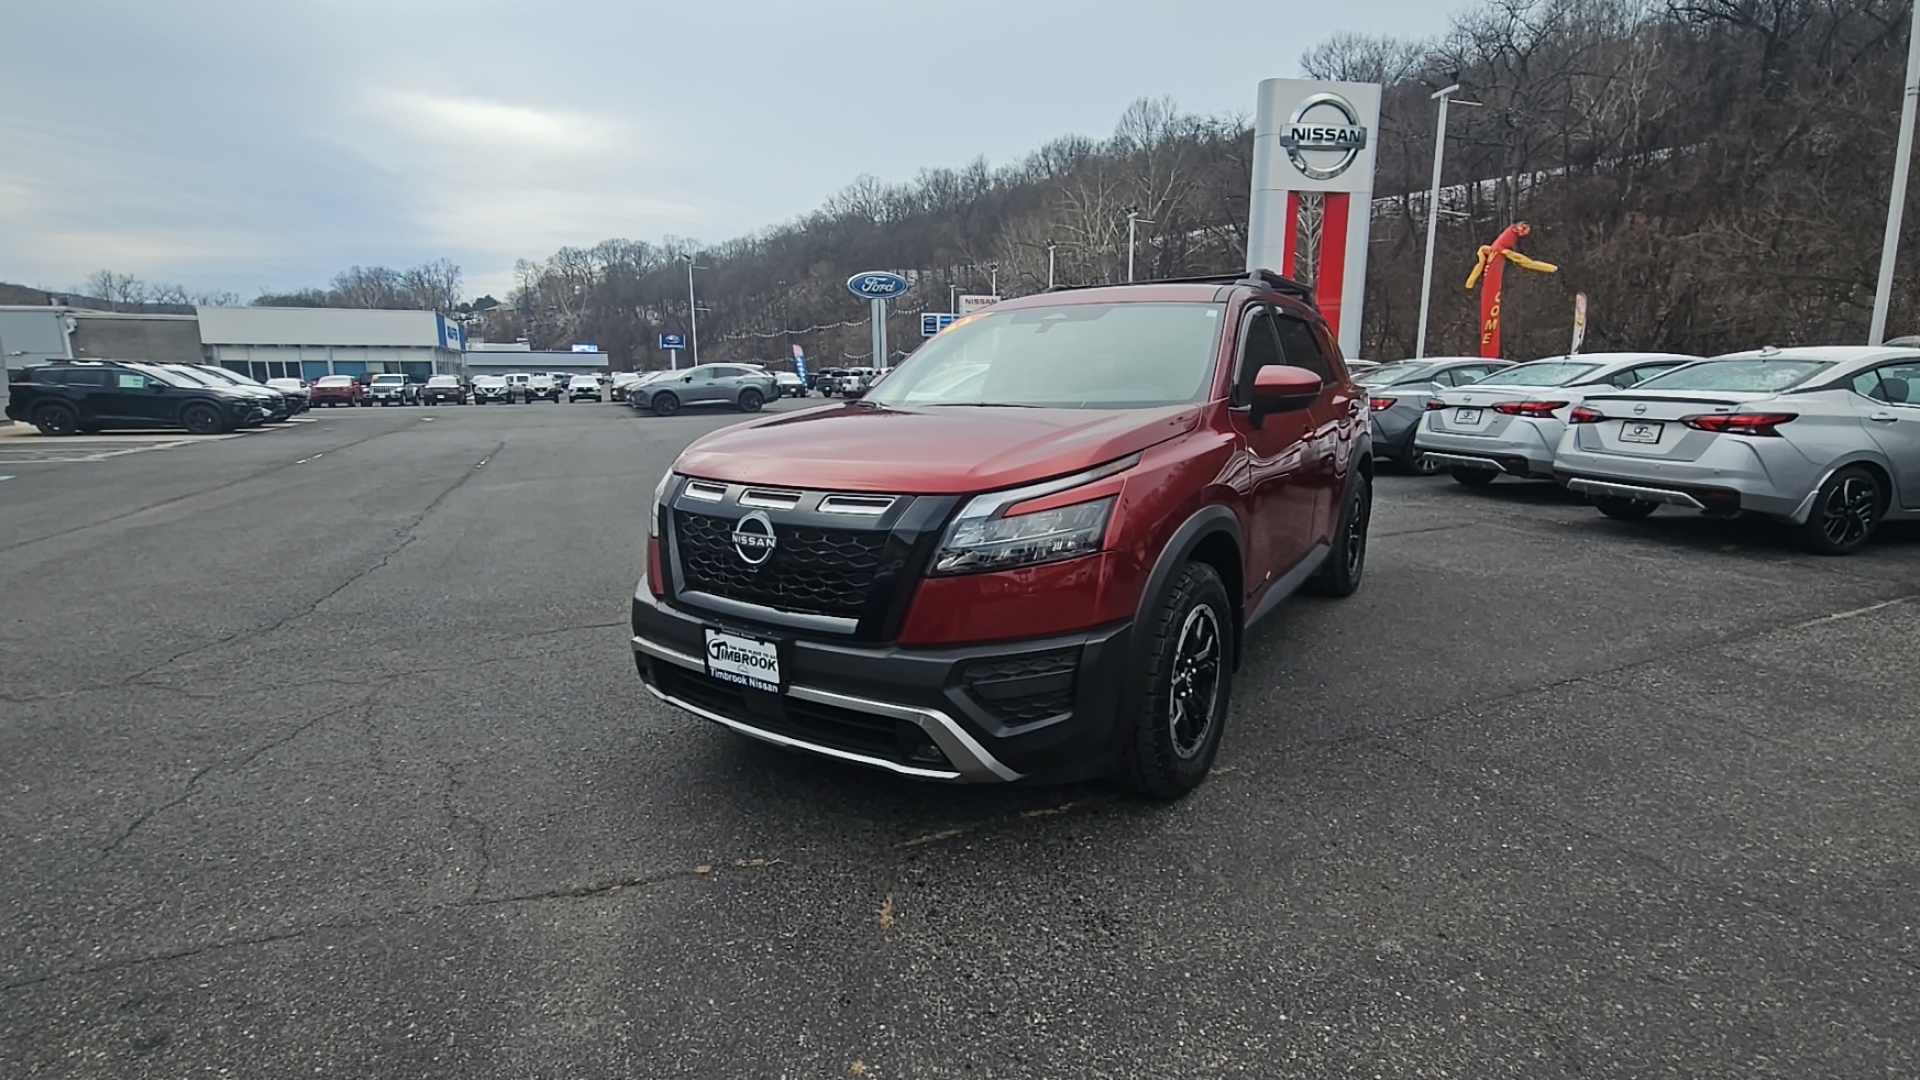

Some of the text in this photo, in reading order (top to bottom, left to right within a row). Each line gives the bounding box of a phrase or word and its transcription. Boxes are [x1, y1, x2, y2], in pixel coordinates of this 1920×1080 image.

[1291, 127, 1361, 143] NISSAN
[861, 276, 896, 293] Ford
[964, 298, 998, 306] NISSAN
[731, 533, 776, 548] NISSAN
[708, 639, 777, 672] TIMBROOK
[710, 668, 779, 693] Timbrook Nissan
